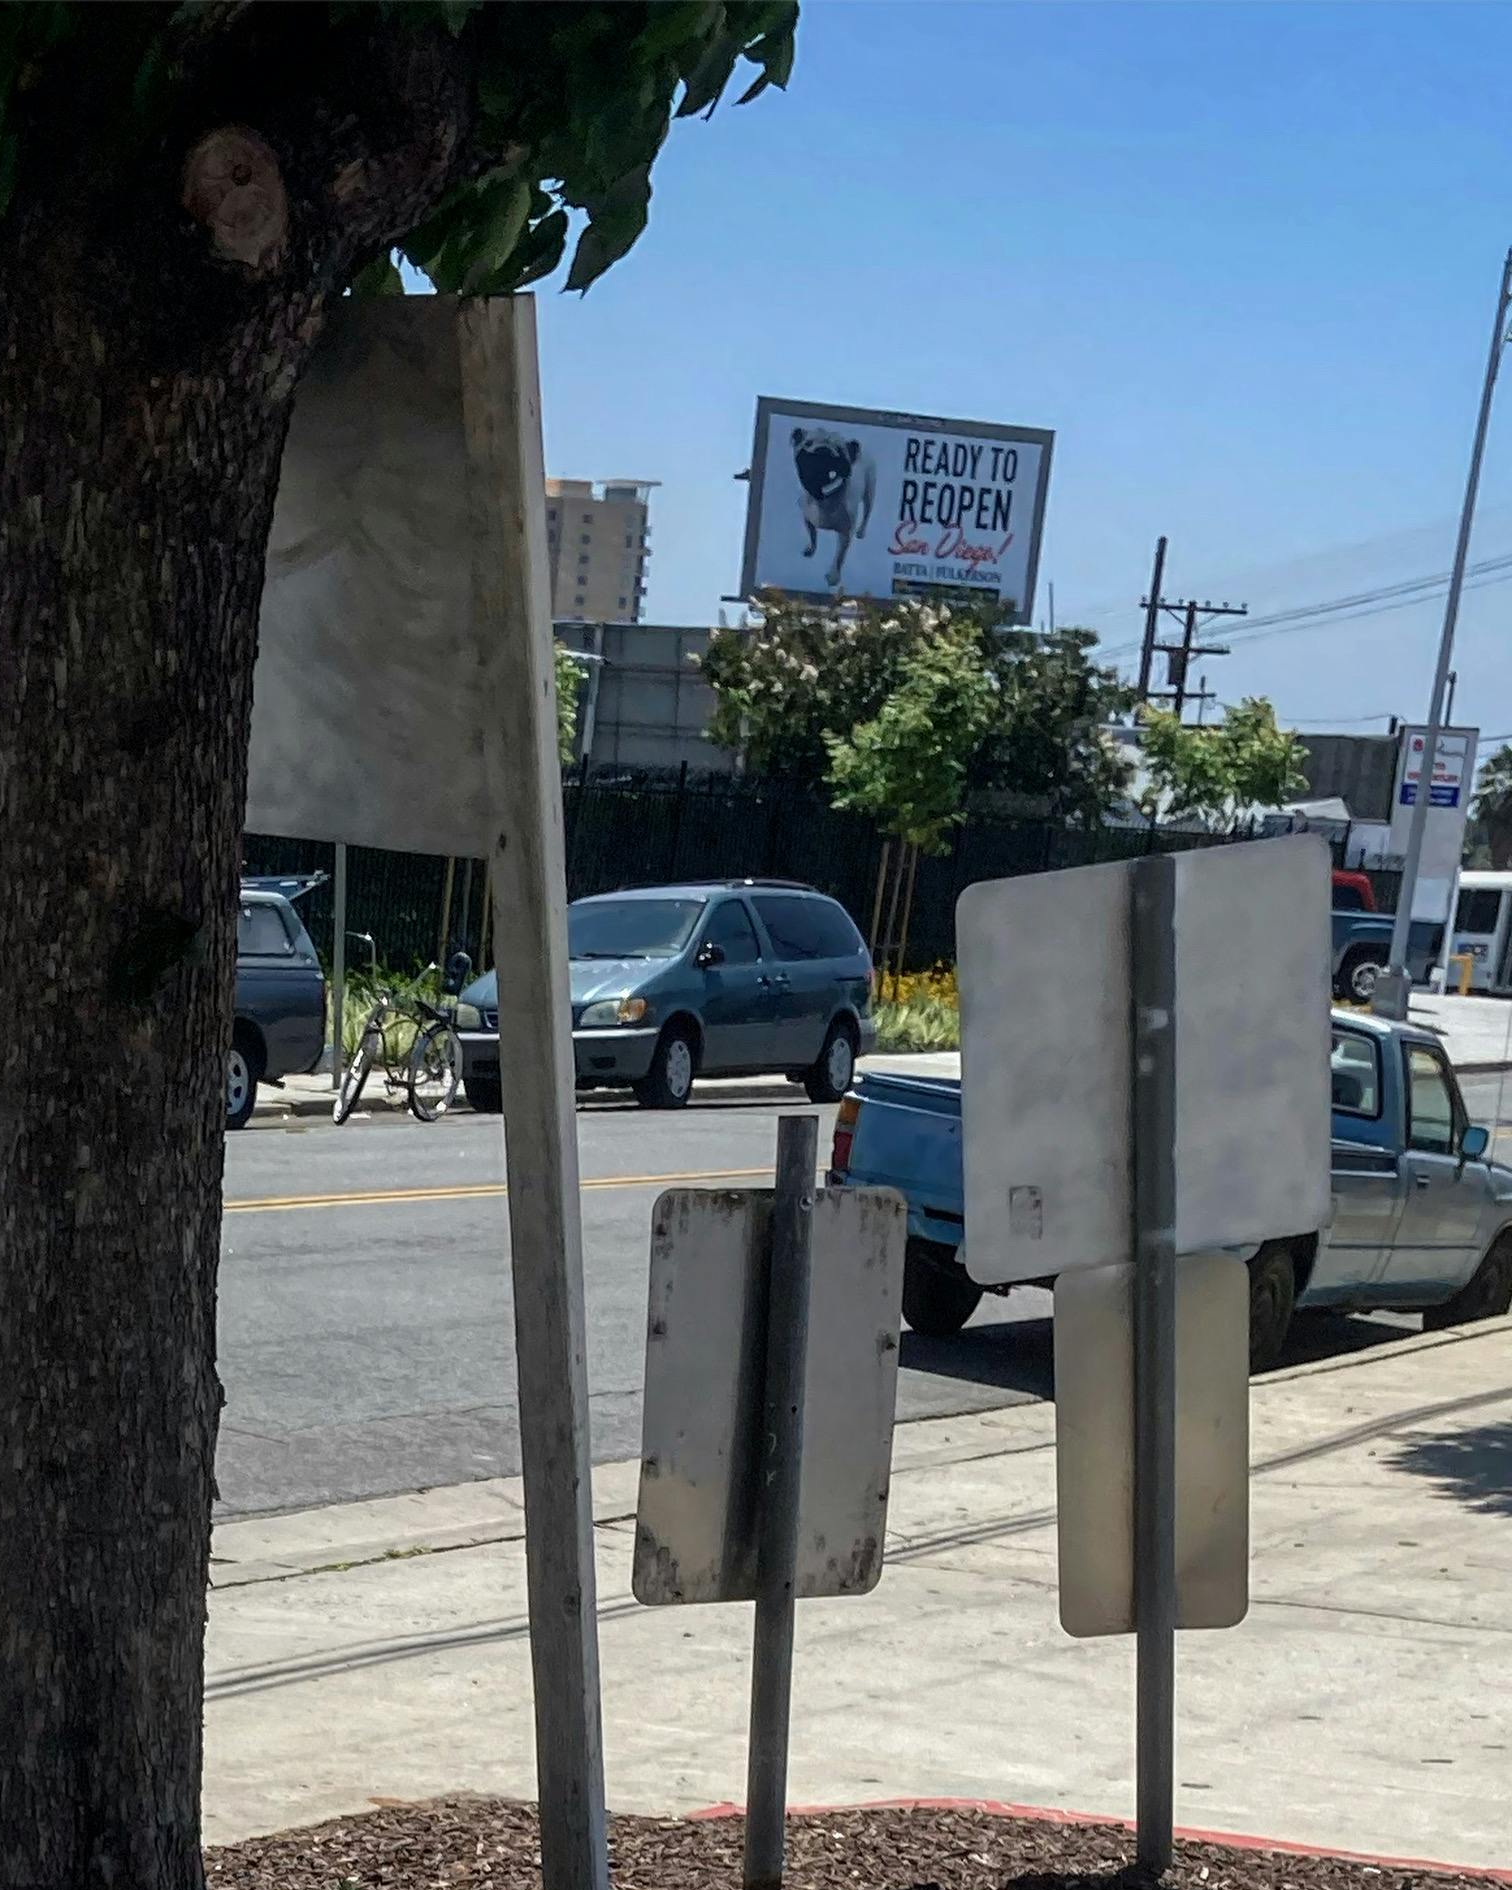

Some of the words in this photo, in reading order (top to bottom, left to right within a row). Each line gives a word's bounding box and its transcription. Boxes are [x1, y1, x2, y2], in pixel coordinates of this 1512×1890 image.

[904, 438, 984, 480] READY
[991, 447, 1018, 484] TO
[899, 479, 1013, 532] REOPEN
[888, 519, 929, 556] San
